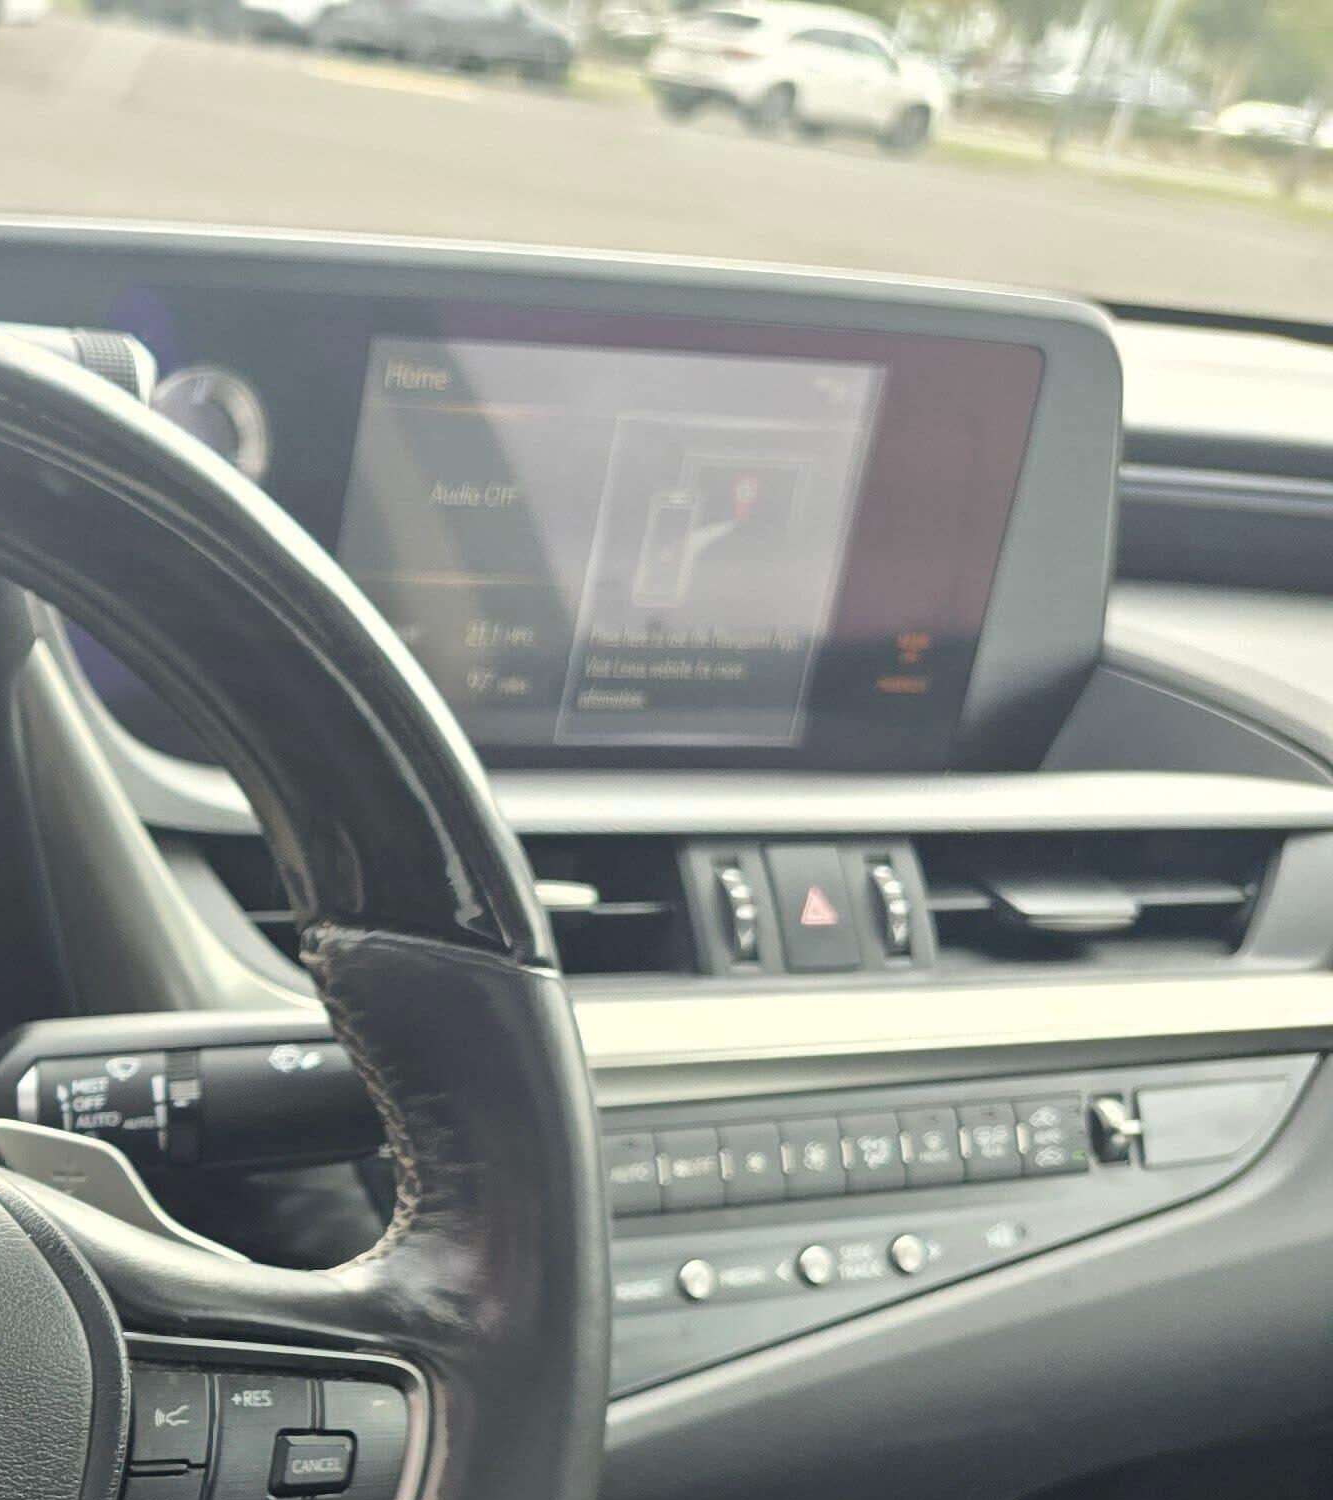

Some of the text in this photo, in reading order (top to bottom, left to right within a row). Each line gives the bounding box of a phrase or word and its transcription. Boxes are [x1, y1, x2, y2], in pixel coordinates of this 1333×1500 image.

[385, 359, 449, 392] Home
[430, 481, 480, 507] Audio
[290, 1456, 344, 1475] CANCEL
